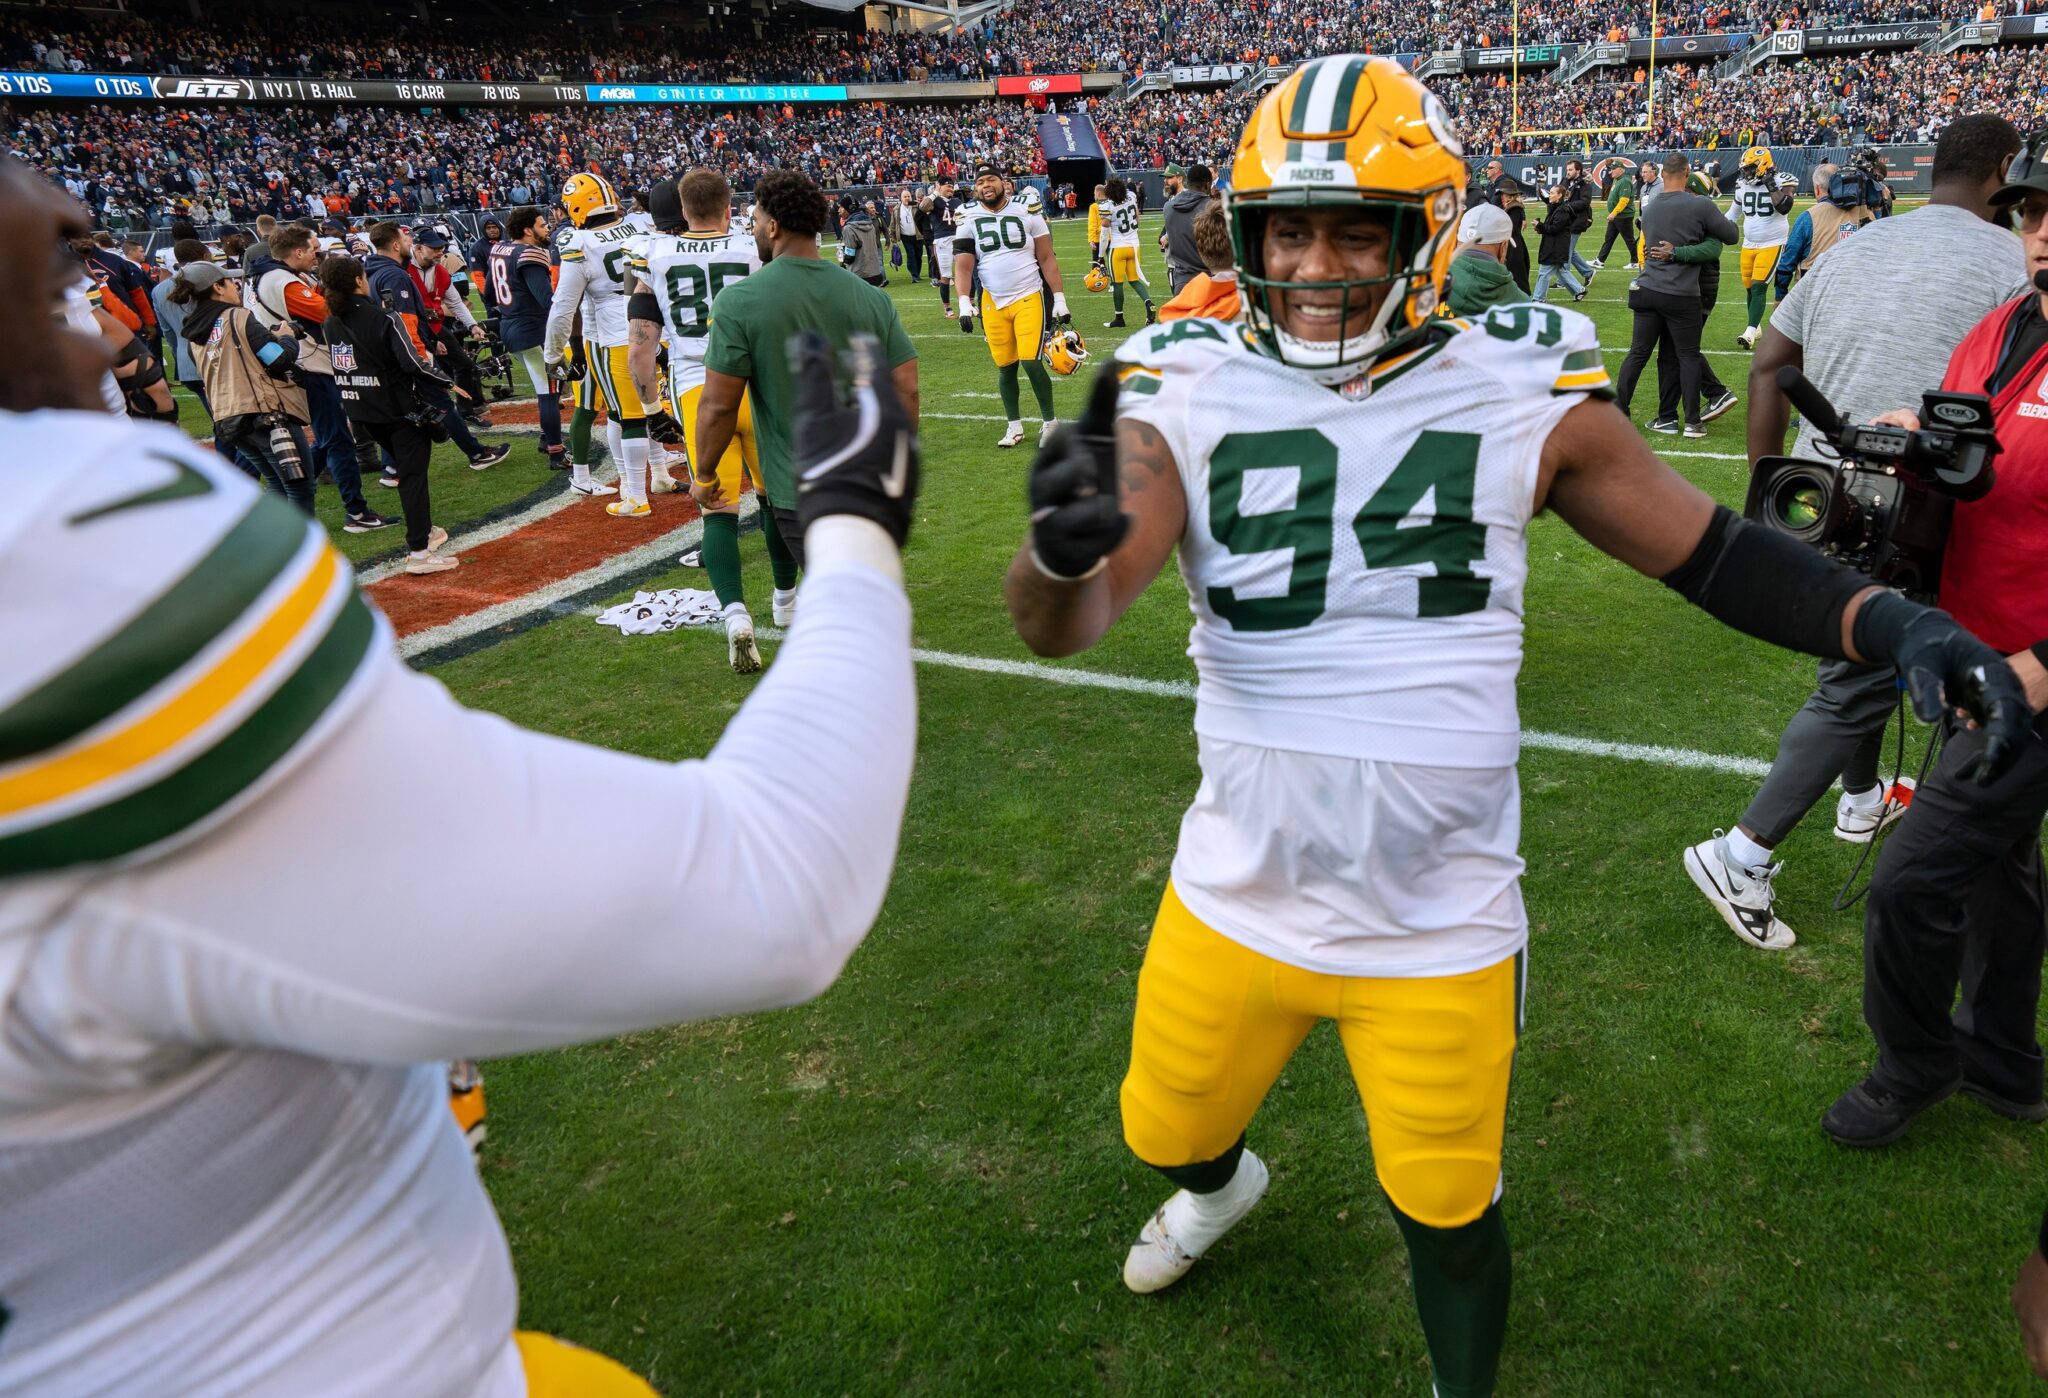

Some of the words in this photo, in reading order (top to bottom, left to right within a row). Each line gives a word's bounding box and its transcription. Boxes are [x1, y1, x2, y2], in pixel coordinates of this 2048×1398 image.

[1828, 31, 1901, 44] HOLLYWOOD
[1966, 28, 1978, 37] 153
[1777, 34, 1798, 50] 40
[1478, 50, 1525, 64] ESPN
[1526, 46, 1562, 62] BET
[13, 76, 52, 93] YDS
[166, 78, 240, 98] JETS
[262, 82, 293, 97] NYJ
[310, 83, 326, 98] B.
[395, 85, 411, 99] 16
[412, 85, 446, 99] CARR
[481, 86, 497, 99] 78
[498, 87, 521, 100] YDS
[600, 87, 636, 99] AMGEN
[1289, 168, 1335, 181] PACKERS
[1744, 191, 1775, 217] 95
[1116, 204, 1138, 233] 33
[594, 222, 638, 243] SLATON
[974, 215, 1027, 253] 50
[676, 239, 732, 253] KRAFT
[491, 256, 513, 306] 18
[335, 354, 357, 369] NFL
[351, 376, 381, 387] MEDIA
[341, 390, 360, 400] 031
